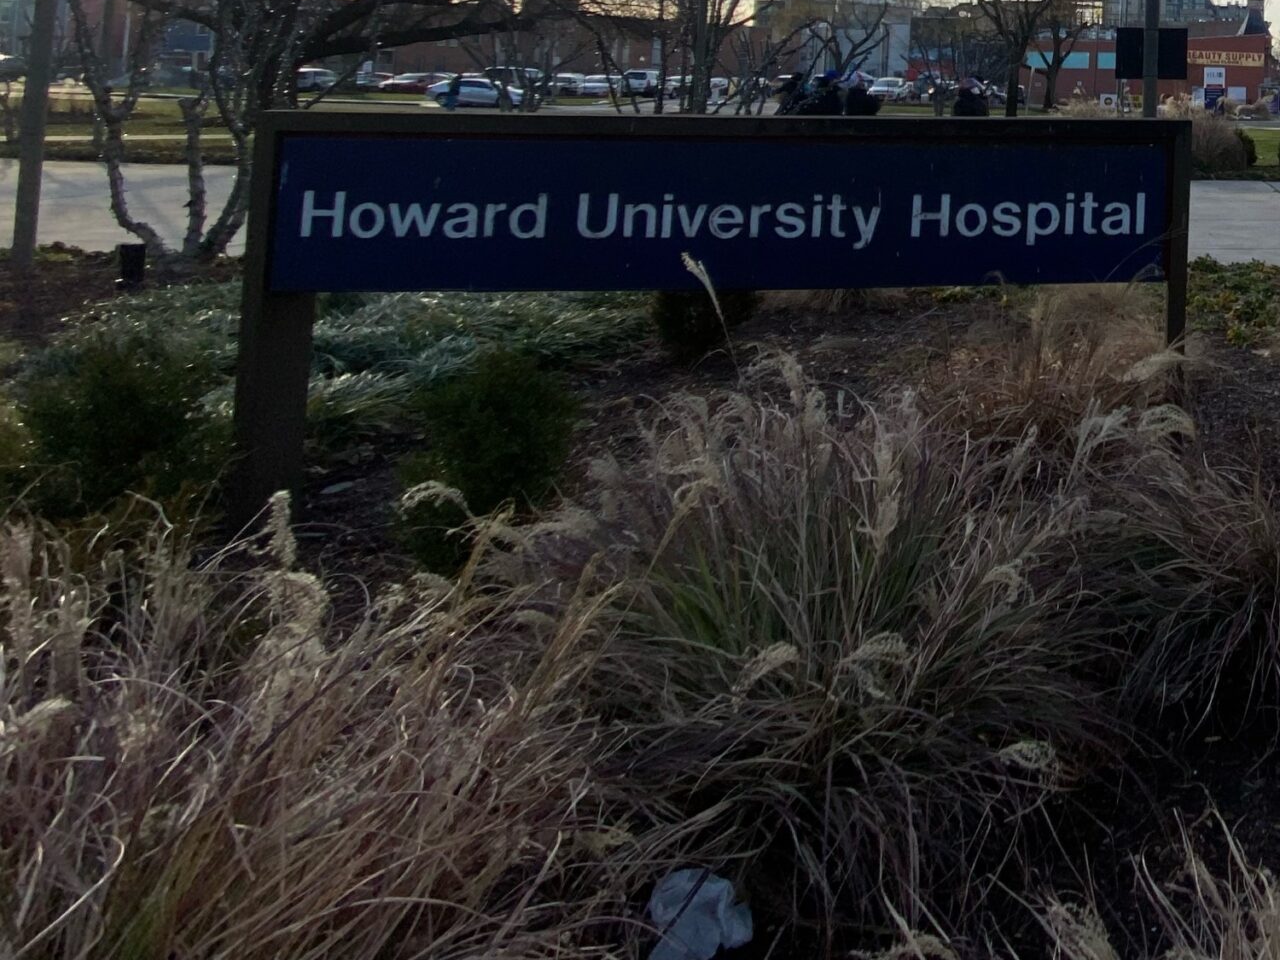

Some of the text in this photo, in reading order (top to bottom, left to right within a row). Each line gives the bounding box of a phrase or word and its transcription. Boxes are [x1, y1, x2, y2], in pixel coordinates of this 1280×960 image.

[1225, 52, 1262, 62] SUPPLY
[300, 190, 1147, 250] Howard University Hospital
